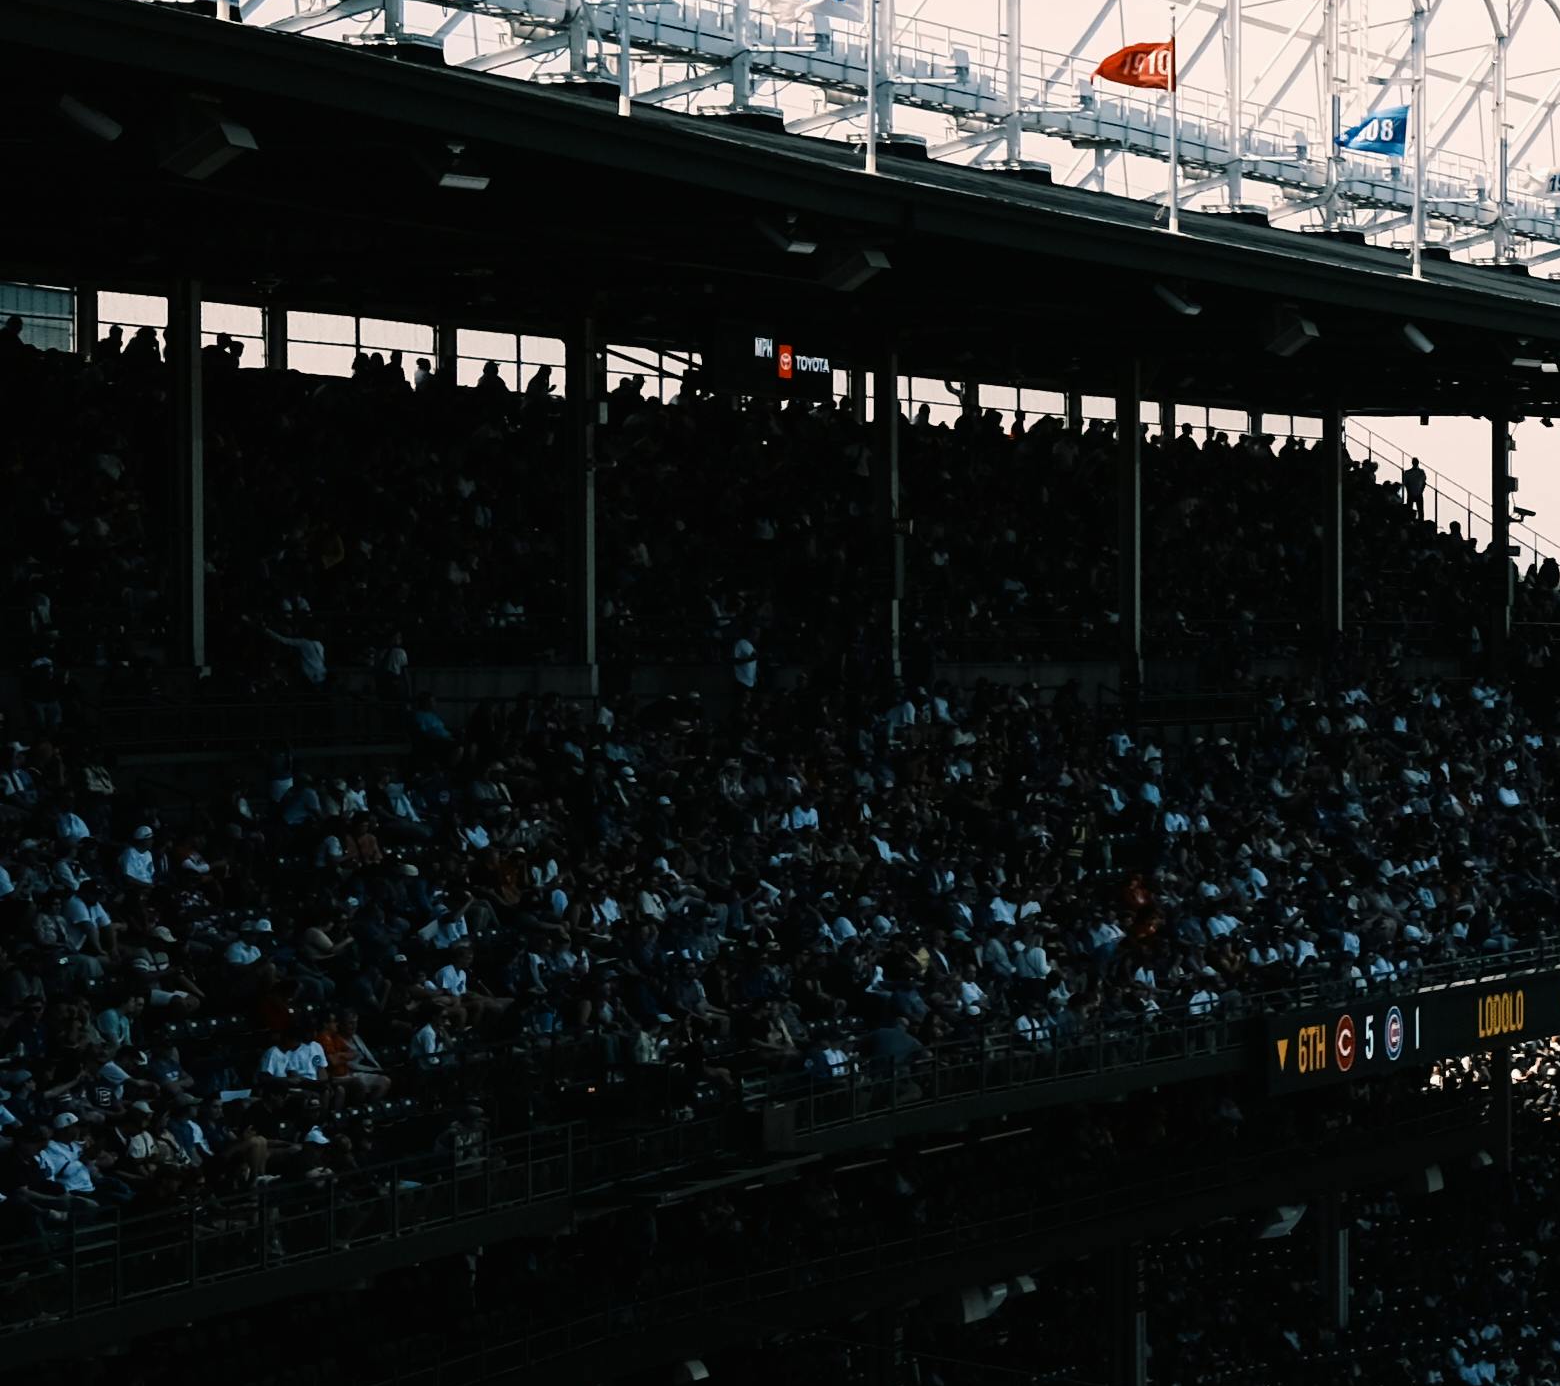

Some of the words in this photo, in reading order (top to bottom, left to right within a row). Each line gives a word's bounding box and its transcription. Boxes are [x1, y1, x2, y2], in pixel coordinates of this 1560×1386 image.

[754, 336, 773, 358] MPH
[795, 355, 830, 373] TOYOTA
[1298, 1024, 1326, 1073] 6TH
[1365, 1015, 1375, 1060] 5
[1477, 989, 1524, 1039] LODOLO
